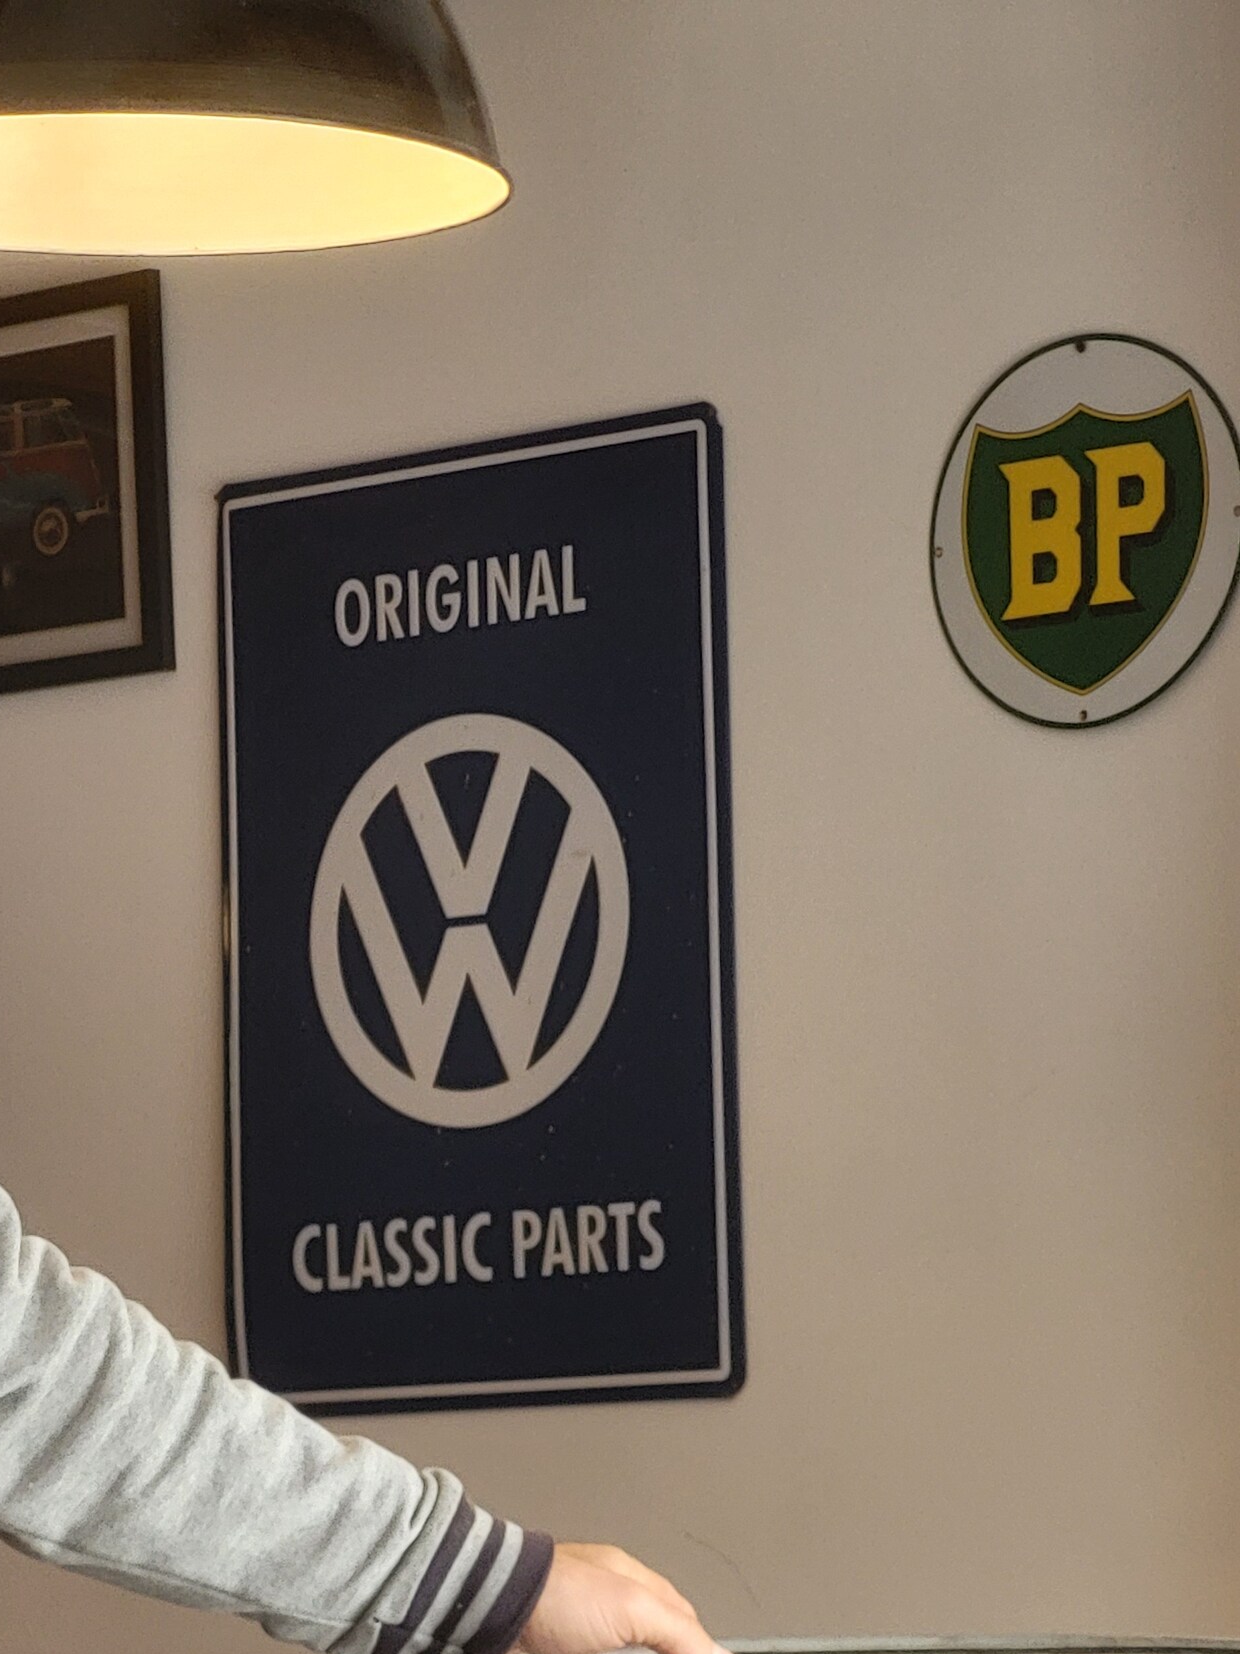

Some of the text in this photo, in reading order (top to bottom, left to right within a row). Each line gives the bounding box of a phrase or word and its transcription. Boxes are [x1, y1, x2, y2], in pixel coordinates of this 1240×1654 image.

[335, 546, 587, 647] ORIGINAL
[999, 442, 1165, 620] BP
[318, 723, 623, 1118] VW
[294, 1201, 665, 1293] CLASSIC PARTS
